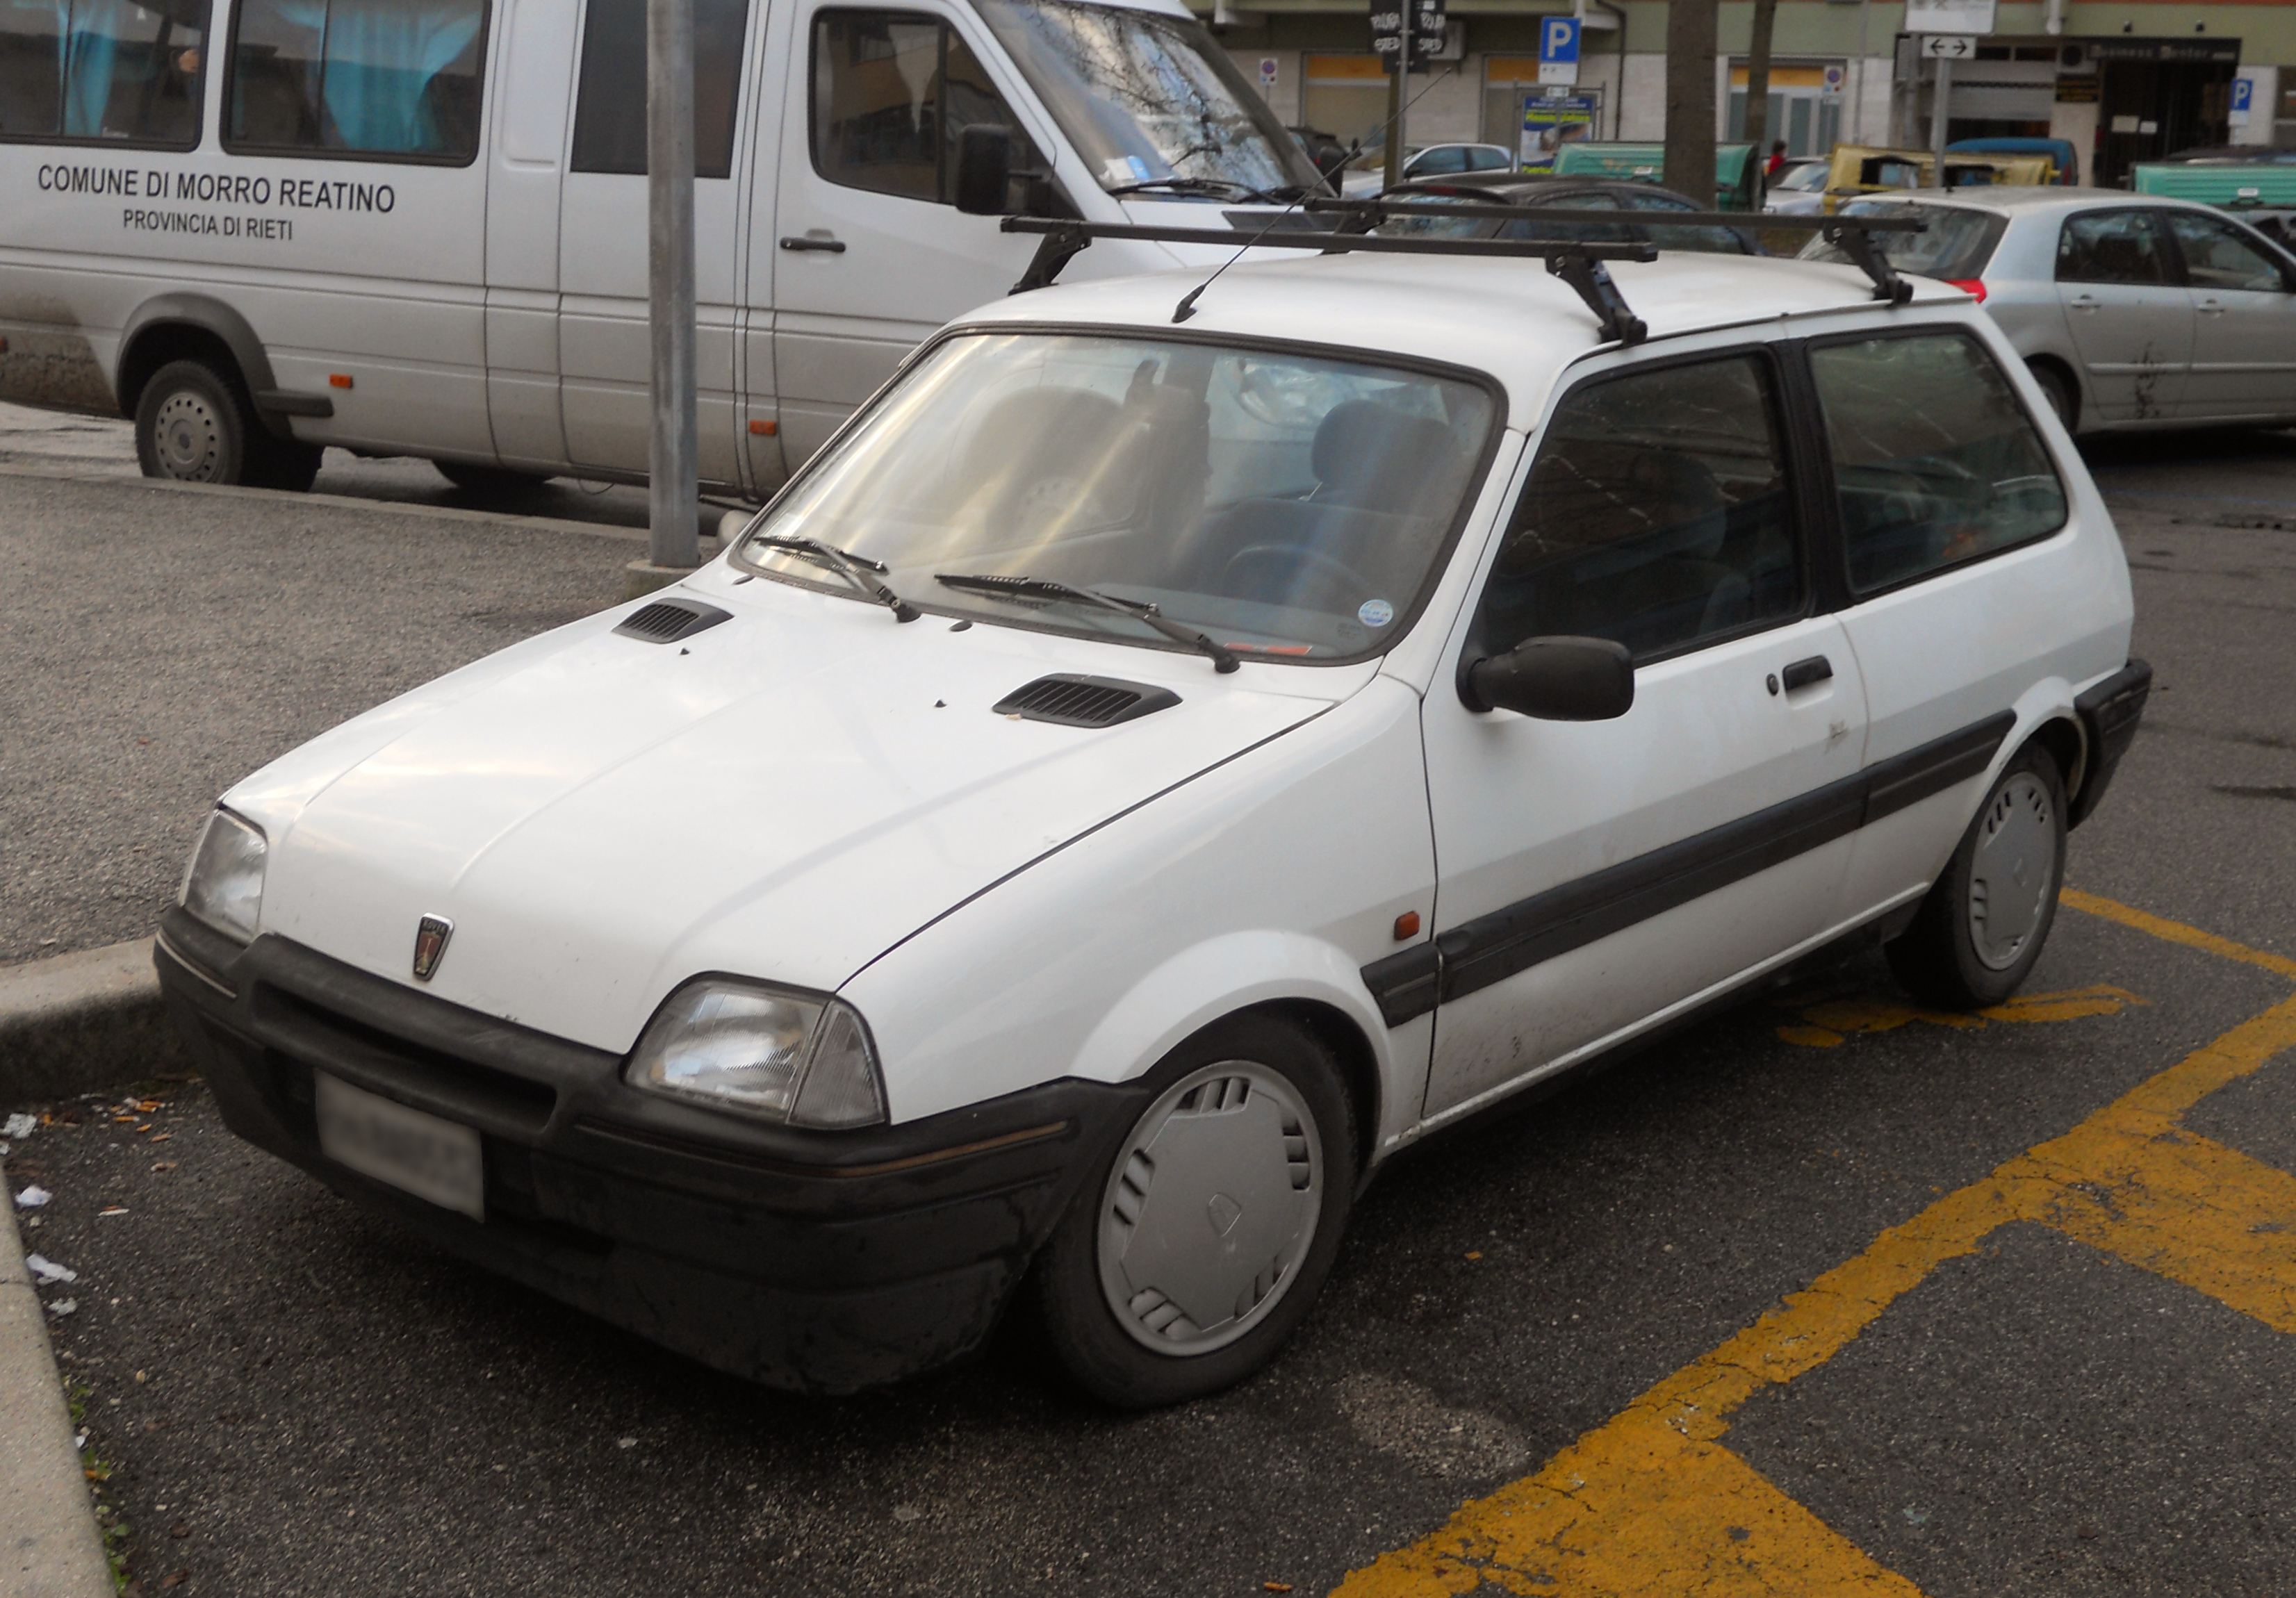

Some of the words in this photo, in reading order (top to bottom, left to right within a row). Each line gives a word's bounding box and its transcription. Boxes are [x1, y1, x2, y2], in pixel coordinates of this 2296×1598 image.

[1548, 22, 1572, 58] P
[2235, 82, 2249, 107] P
[38, 165, 138, 196] COMUNE
[147, 172, 169, 197] DI
[177, 174, 270, 205] MORRO
[279, 181, 395, 213] REATINO
[124, 210, 217, 235] PROVINCIA
[224, 216, 241, 236] DI
[247, 219, 293, 240] RIETI
